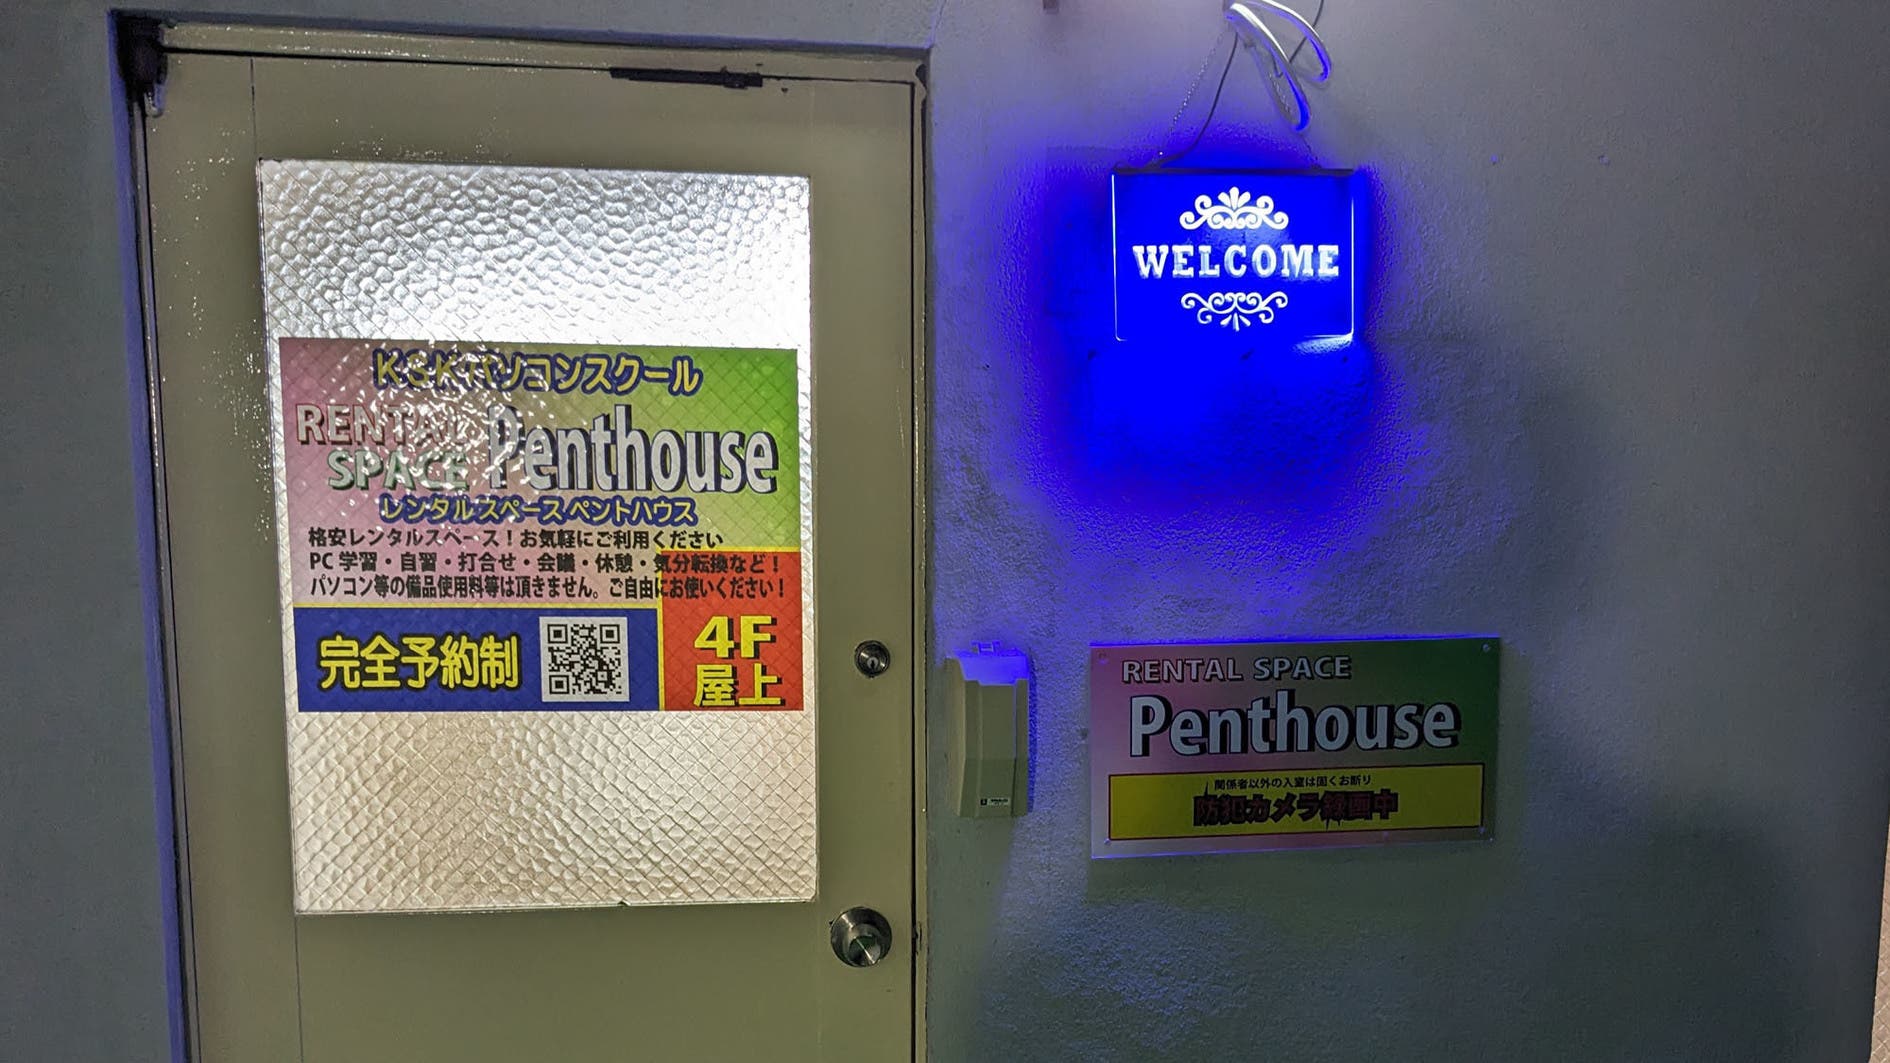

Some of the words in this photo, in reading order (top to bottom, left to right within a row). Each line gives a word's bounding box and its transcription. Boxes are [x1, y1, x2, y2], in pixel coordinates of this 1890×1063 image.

[1132, 244, 1339, 278] WELCOME
[296, 403, 474, 445] RENTAL
[487, 403, 779, 494] Penthouse
[327, 449, 470, 491] SPACE
[694, 615, 776, 659] 4F
[318, 634, 519, 690] 完全予約制
[1121, 657, 1244, 684] RENTAL
[1254, 656, 1353, 679] SPACE
[694, 664, 787, 708] 屋上
[1129, 690, 1461, 757] Penthouse
[1214, 775, 1372, 791] 関係者以外の入室は固くお断り
[1193, 788, 1399, 826] 防犯カメラ録画中
